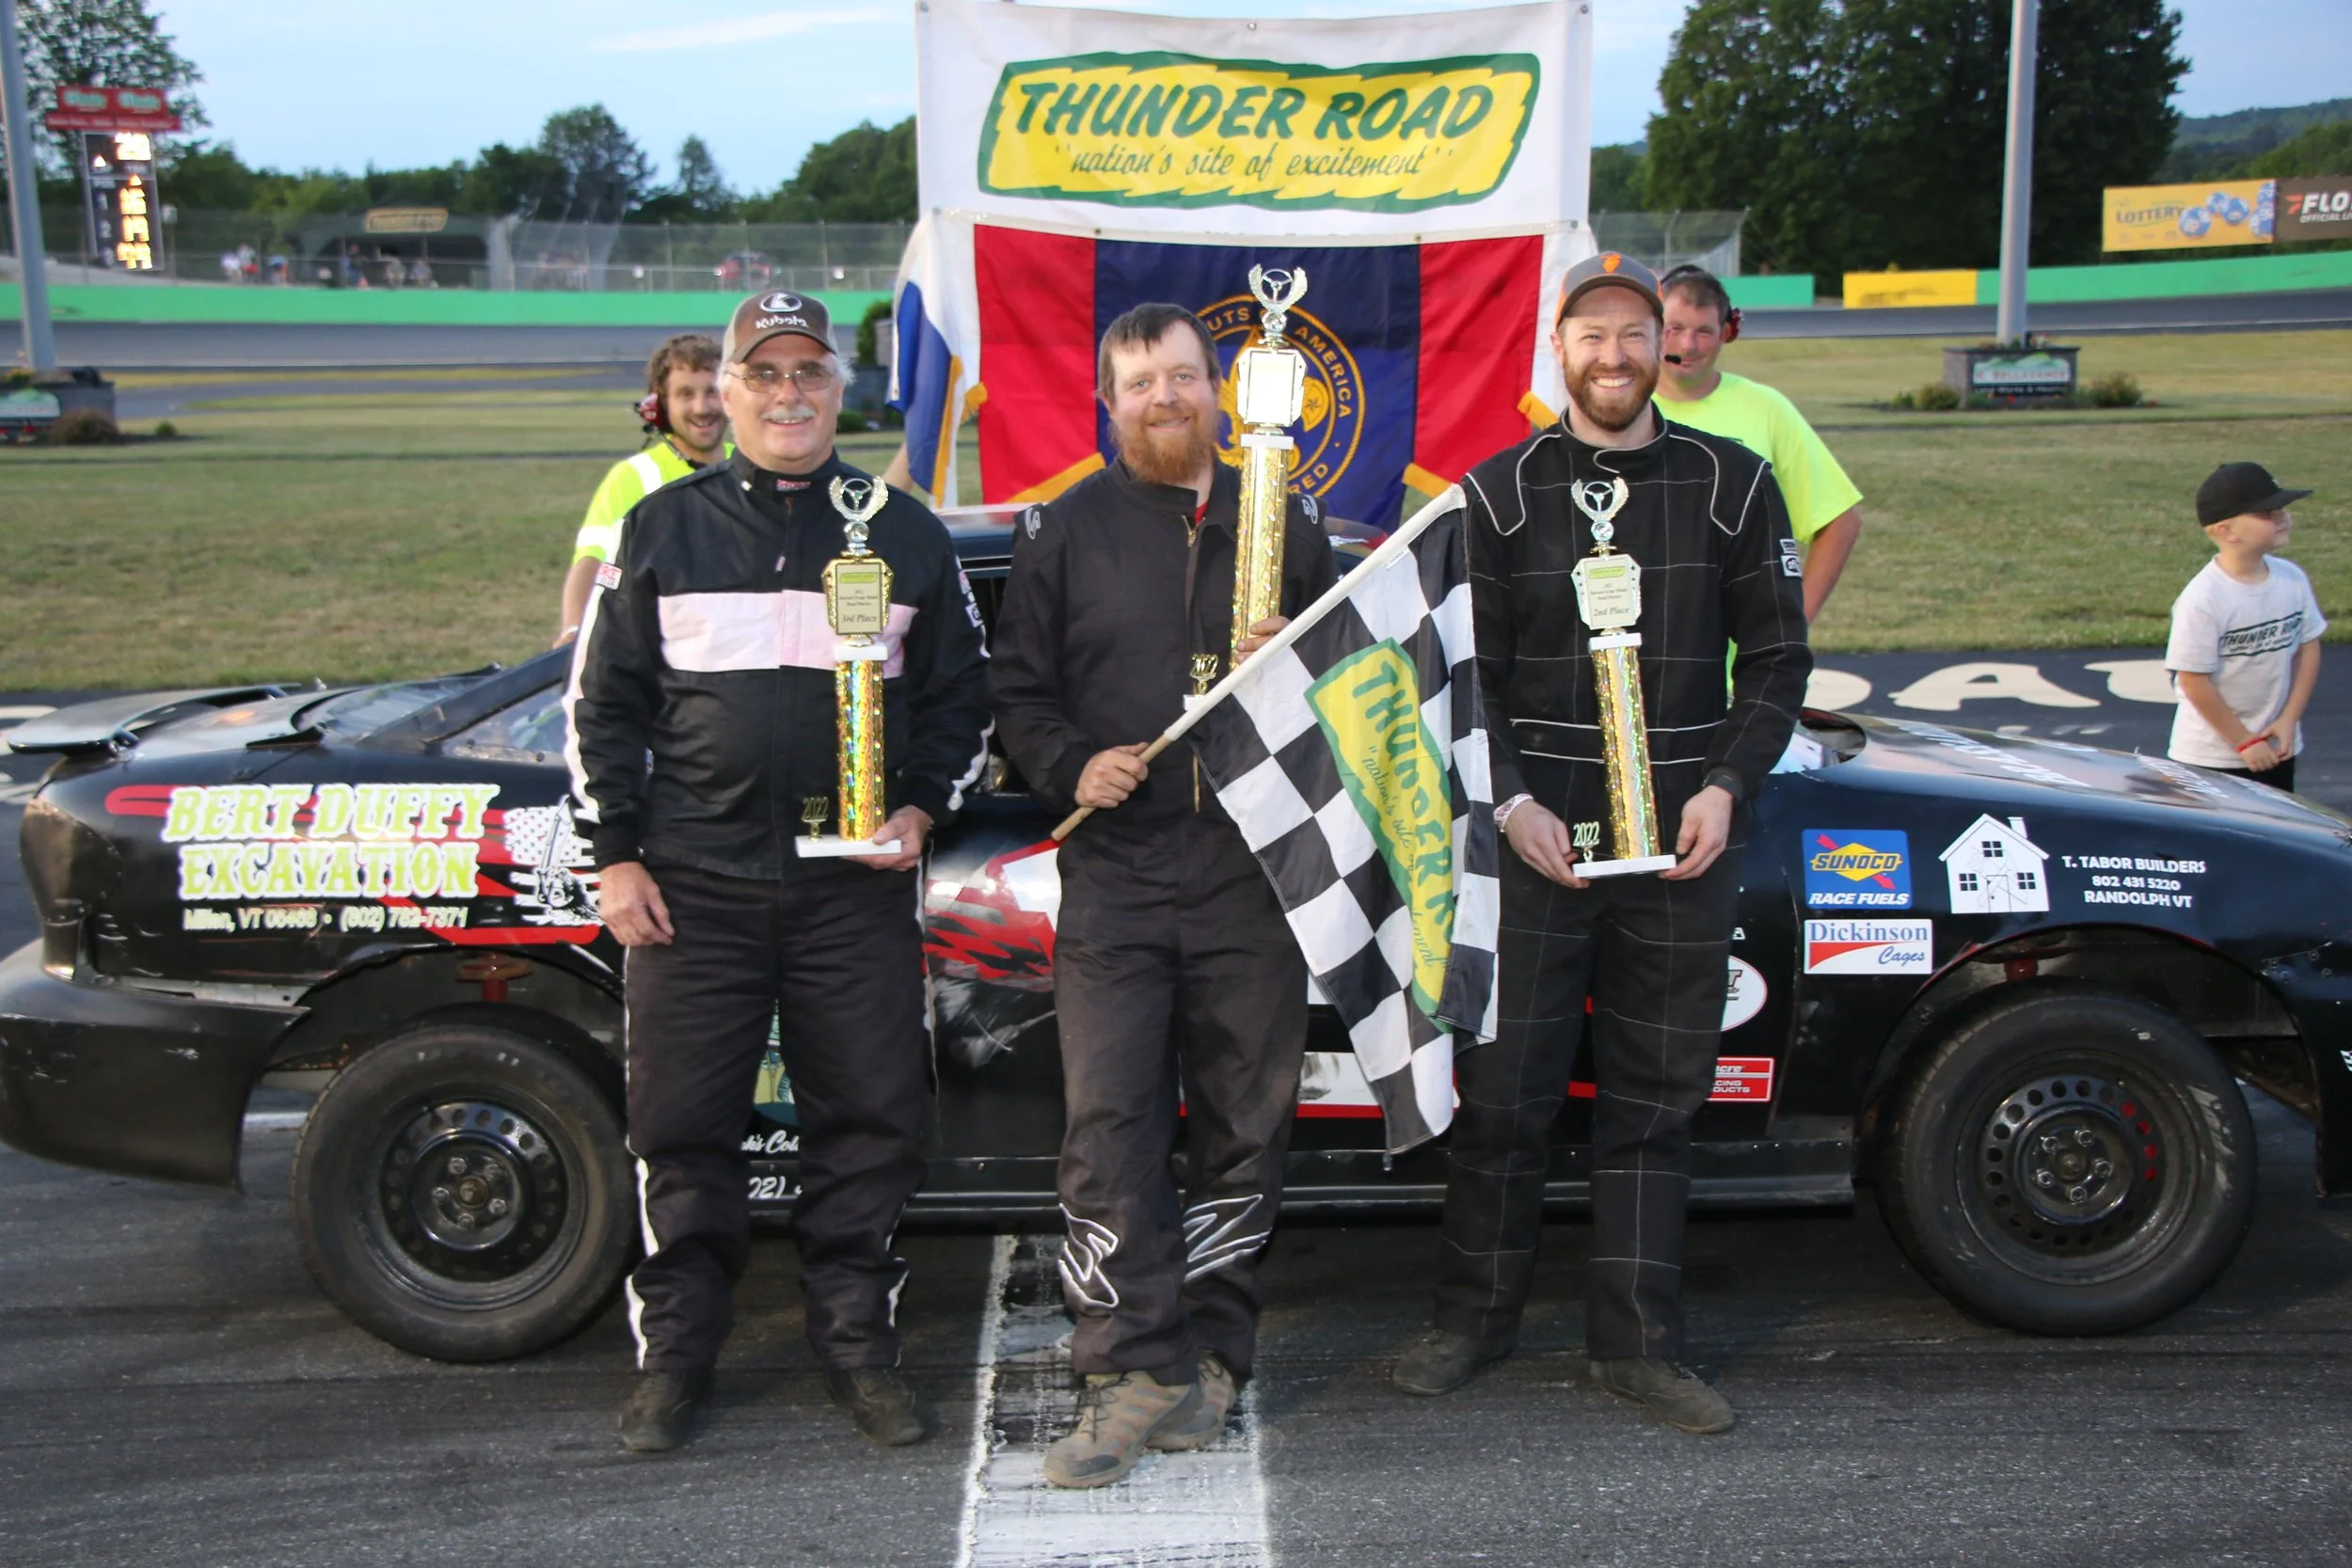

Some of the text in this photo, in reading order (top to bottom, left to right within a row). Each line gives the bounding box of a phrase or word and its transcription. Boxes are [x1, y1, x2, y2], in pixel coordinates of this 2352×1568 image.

[1016, 82, 1494, 141] THUNDER ROAD
[1185, 145, 1234, 176] site
[1245, 141, 1279, 182] of
[2301, 191, 2352, 214] FLO
[1295, 325, 1353, 419] AMERICA
[161, 783, 501, 842] BERT DUFFY
[1572, 820, 1600, 847] 2022
[178, 841, 481, 899] EXCAVATION
[1814, 855, 1899, 870] SUNOCO
[2061, 855, 2207, 874] T. TABOR BUILDERS
[2091, 875, 2182, 891] 802 431 5220
[1808, 893, 1910, 905] RACE FUELS
[2083, 890, 2193, 909] RANDOLPH VT
[237, 908, 264, 929] VT
[1809, 922, 1928, 942] Dickinson
[1878, 945, 1925, 967] Cages
